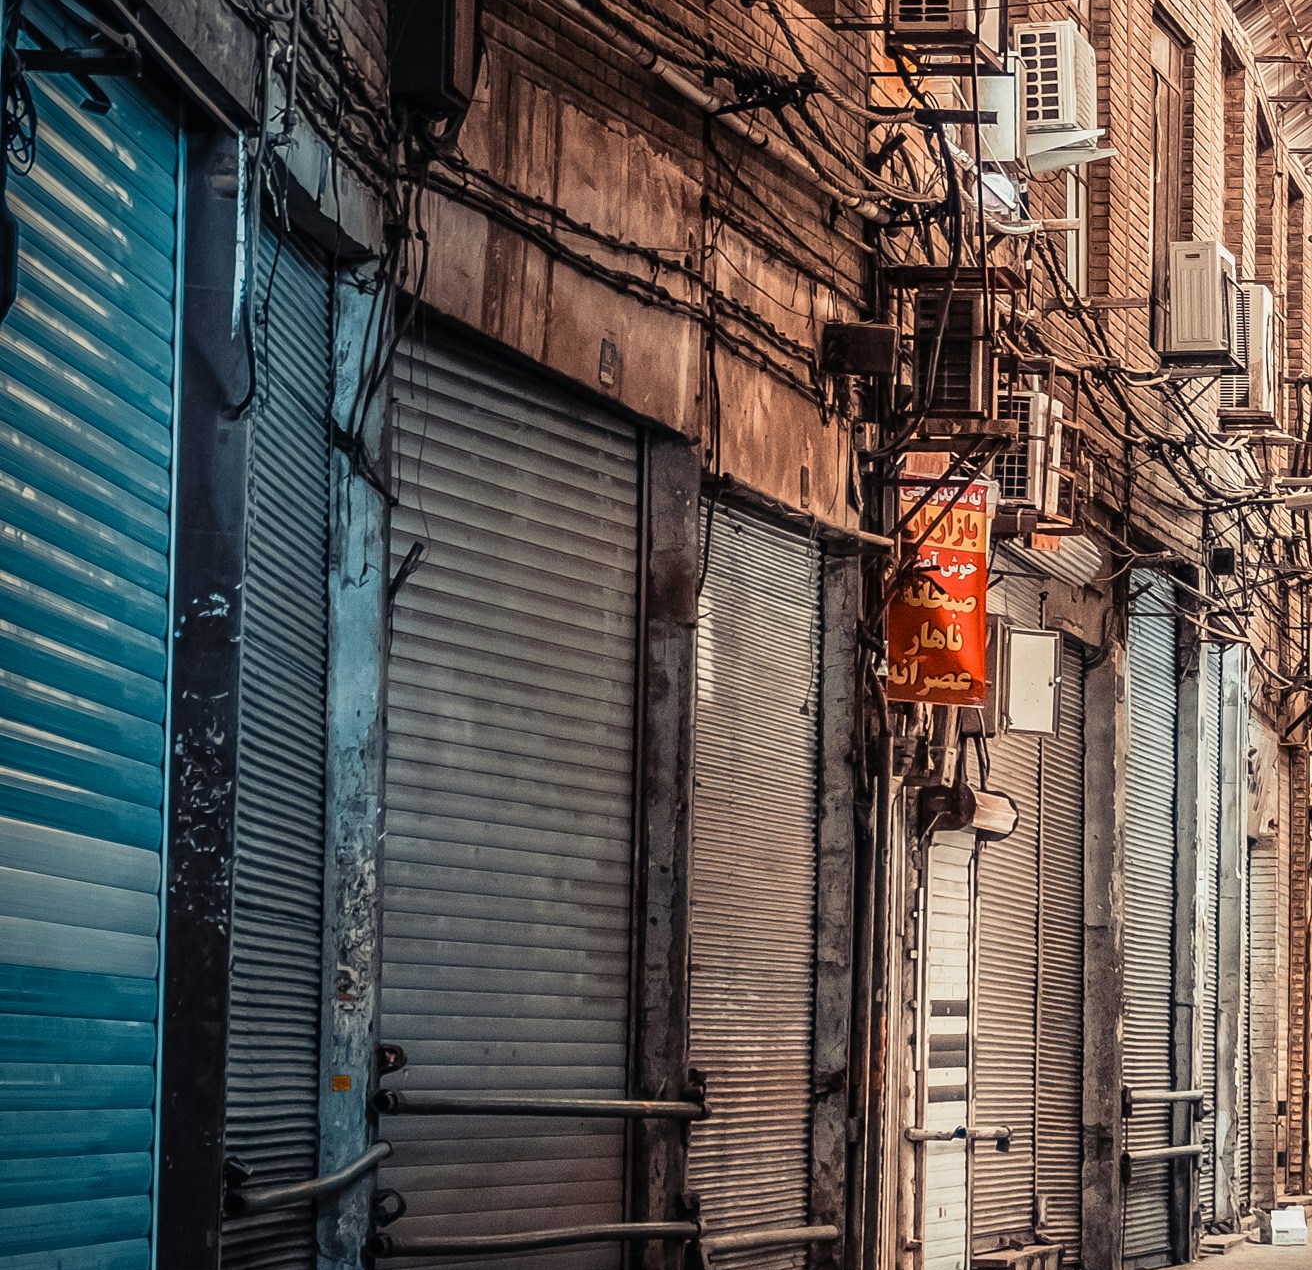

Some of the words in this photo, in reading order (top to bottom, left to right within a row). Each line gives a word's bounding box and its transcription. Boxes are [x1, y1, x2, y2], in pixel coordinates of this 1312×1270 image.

[940, 556, 977, 580] خوش
[901, 579, 977, 619] صبحانه
[903, 621, 963, 656] ناهار
